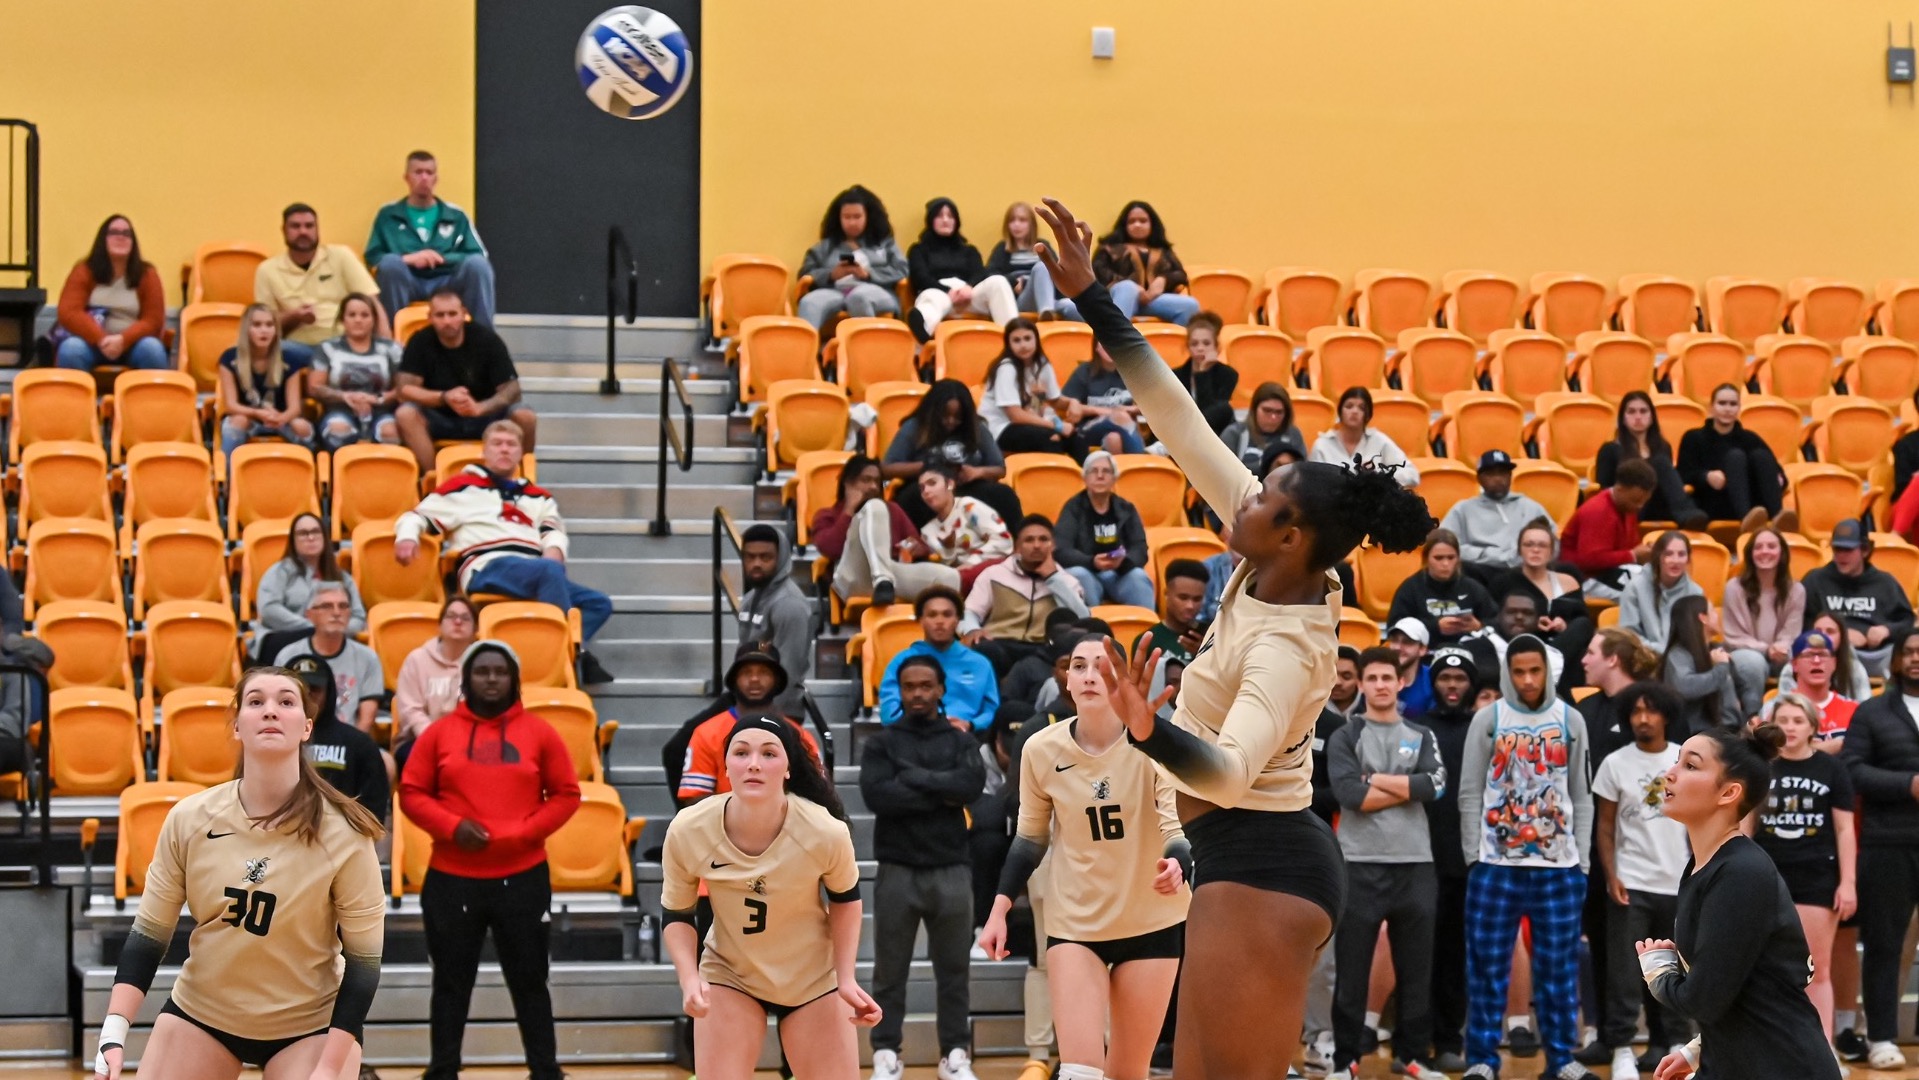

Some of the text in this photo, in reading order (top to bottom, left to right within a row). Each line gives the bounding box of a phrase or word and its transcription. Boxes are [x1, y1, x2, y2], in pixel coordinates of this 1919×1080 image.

[1826, 595, 1876, 611] WVSU
[312, 745, 346, 765] TBALL
[1085, 804, 1125, 841] 16
[221, 886, 277, 936] 30
[743, 898, 767, 935] 3
